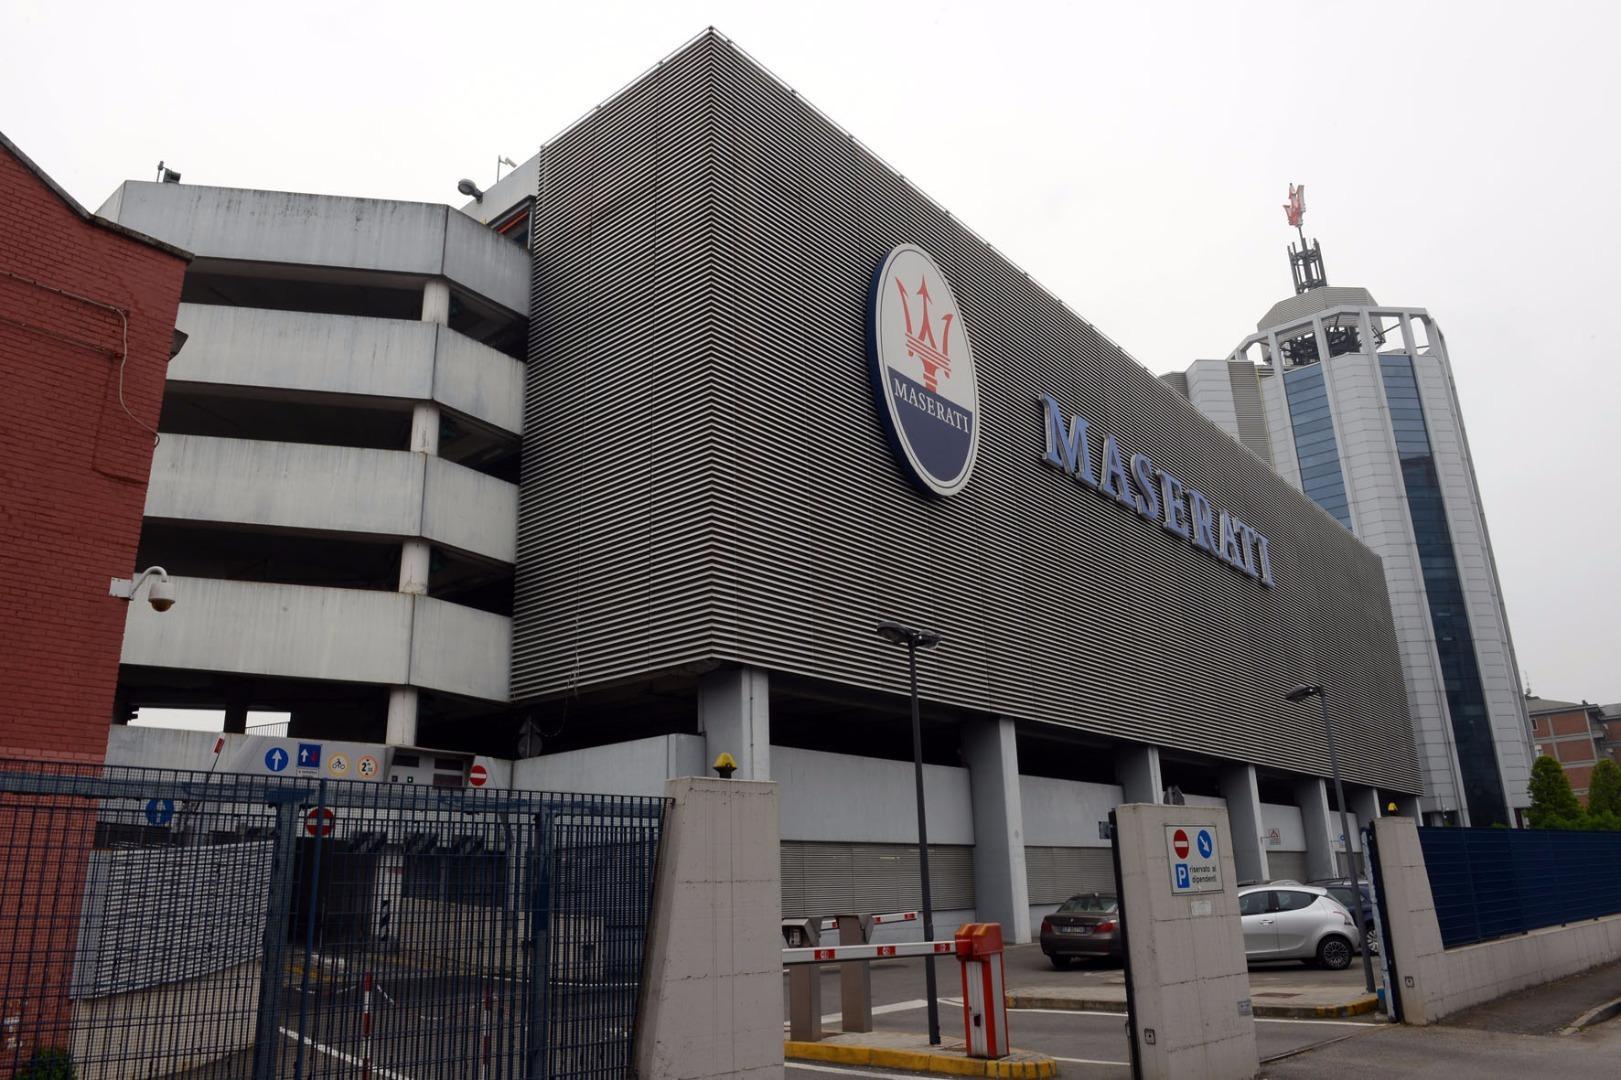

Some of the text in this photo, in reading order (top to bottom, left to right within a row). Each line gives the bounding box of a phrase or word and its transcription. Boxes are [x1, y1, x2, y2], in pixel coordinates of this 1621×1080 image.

[895, 378, 969, 433] MASERATI
[1038, 391, 1275, 589] MASERATI
[1178, 866, 1187, 886] P
